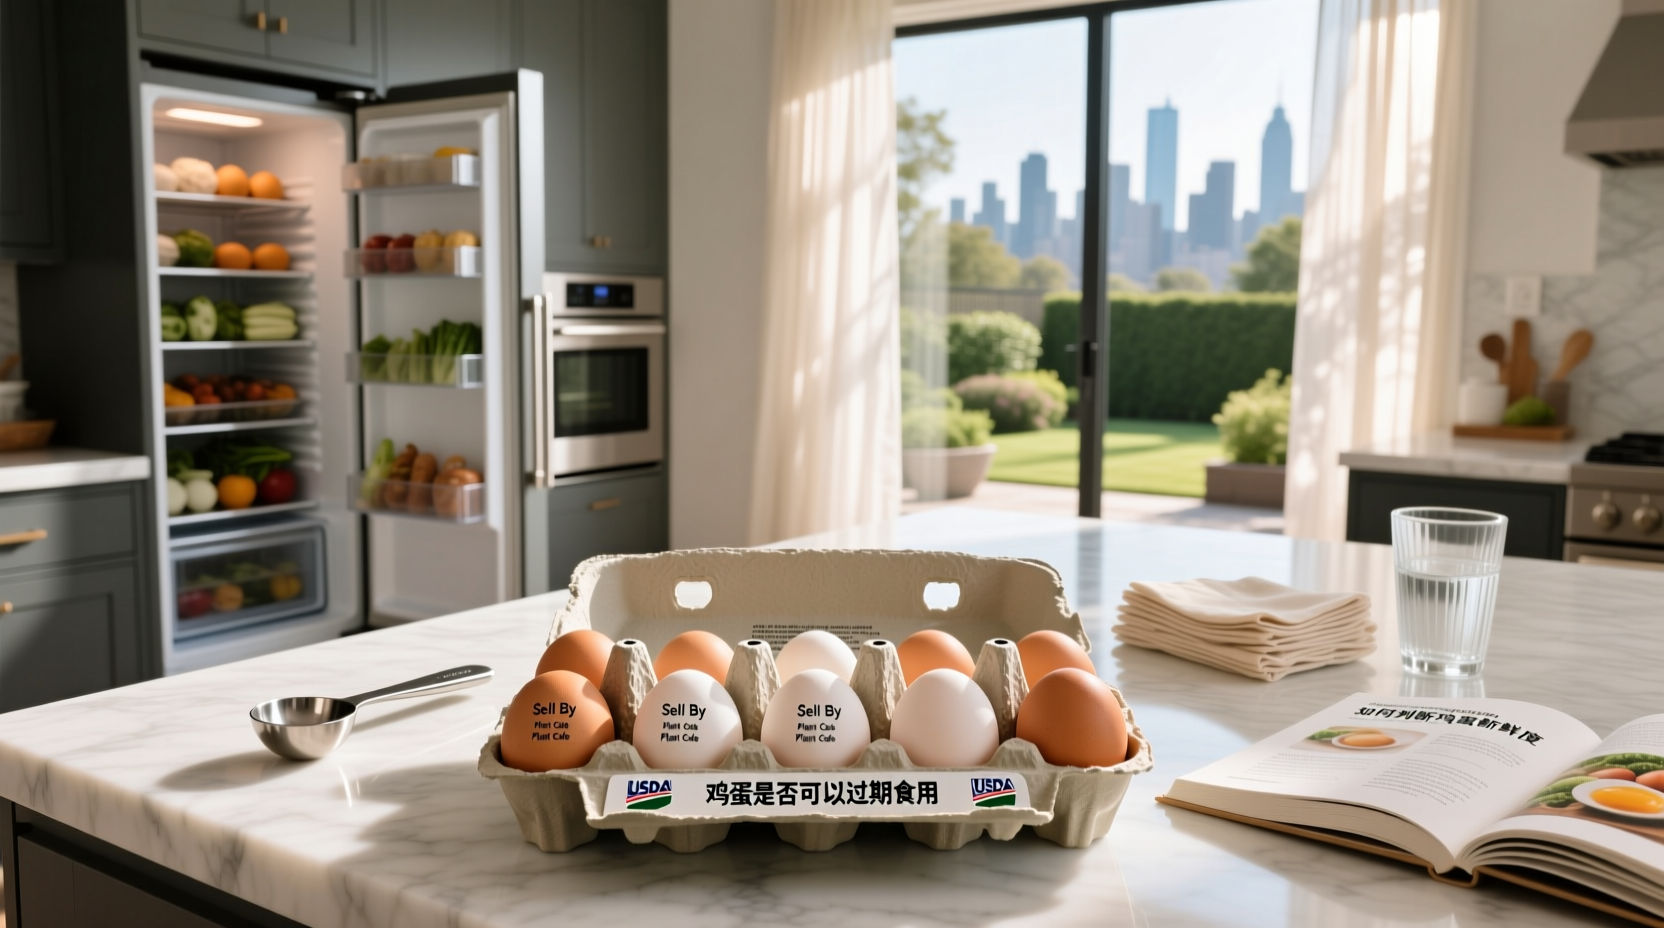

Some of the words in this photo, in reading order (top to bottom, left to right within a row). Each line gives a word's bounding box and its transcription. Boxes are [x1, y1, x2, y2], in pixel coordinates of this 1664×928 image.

[532, 702, 556, 716] Sell
[559, 702, 577, 718] By
[661, 703, 685, 717] Sell
[689, 703, 707, 721] By
[797, 703, 821, 718] Sell
[824, 704, 842, 721] By
[627, 780, 672, 797] USDA
[706, 779, 939, 806] 鸡蛋是否可以过期食用
[971, 778, 1016, 797] USDA
